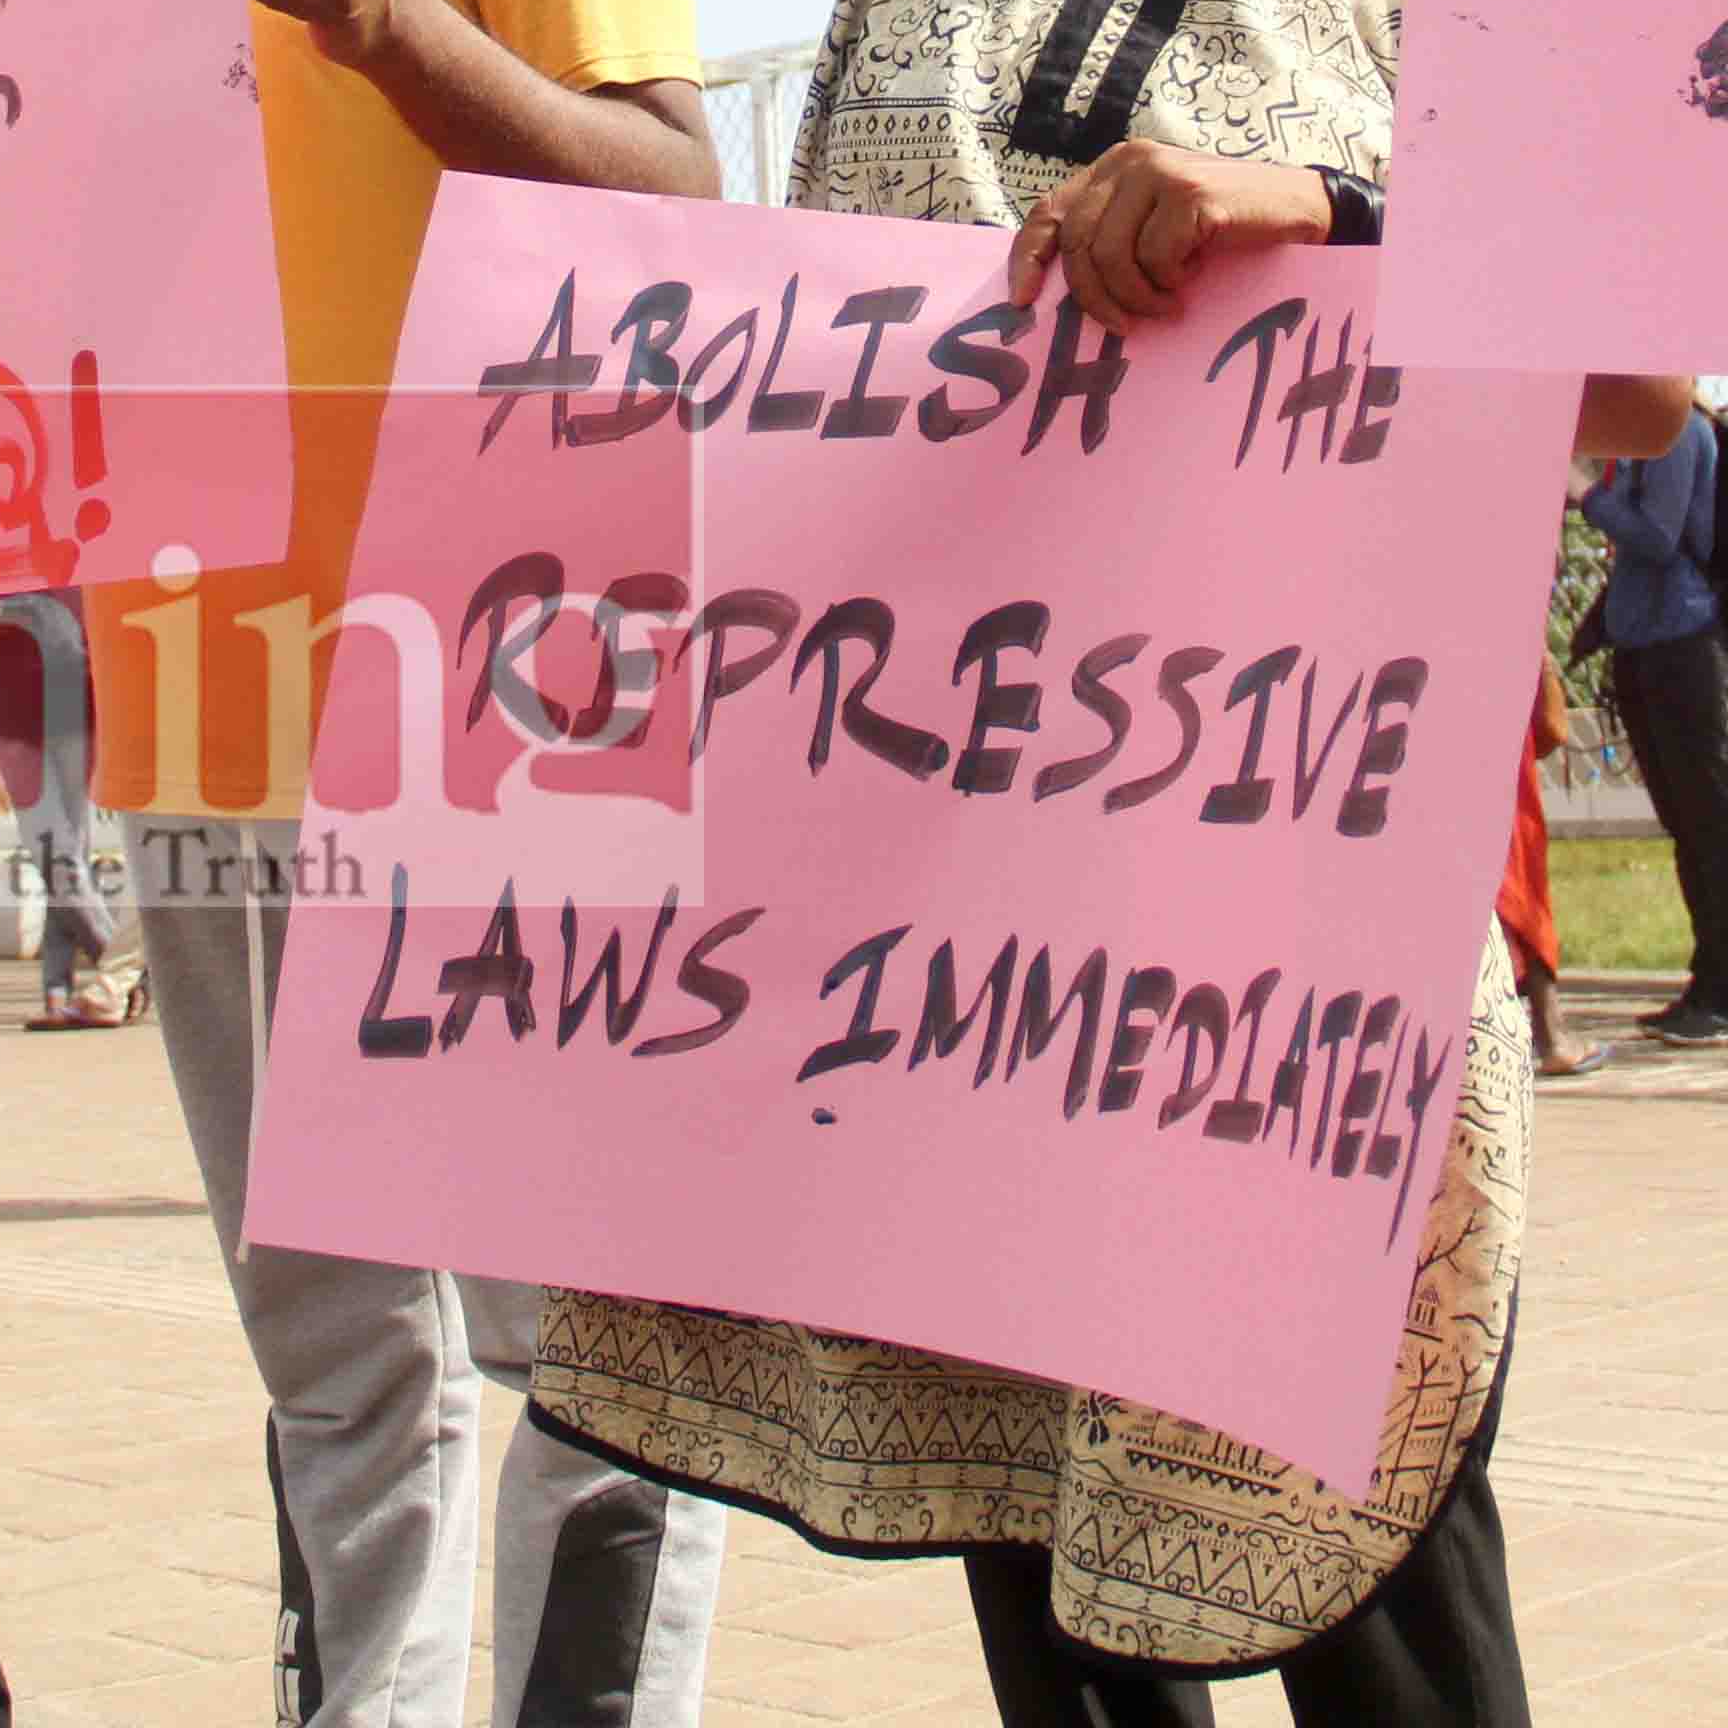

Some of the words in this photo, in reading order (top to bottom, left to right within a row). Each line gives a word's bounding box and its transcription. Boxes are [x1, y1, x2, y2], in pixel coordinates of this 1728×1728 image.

[479, 267, 1131, 456] ABOLISH
[1204, 297, 1404, 475] THE
[458, 552, 1428, 839] REPRESSIVE
[357, 863, 767, 1059] LAWS
[797, 923, 1452, 1256] IMMEDIATELY
